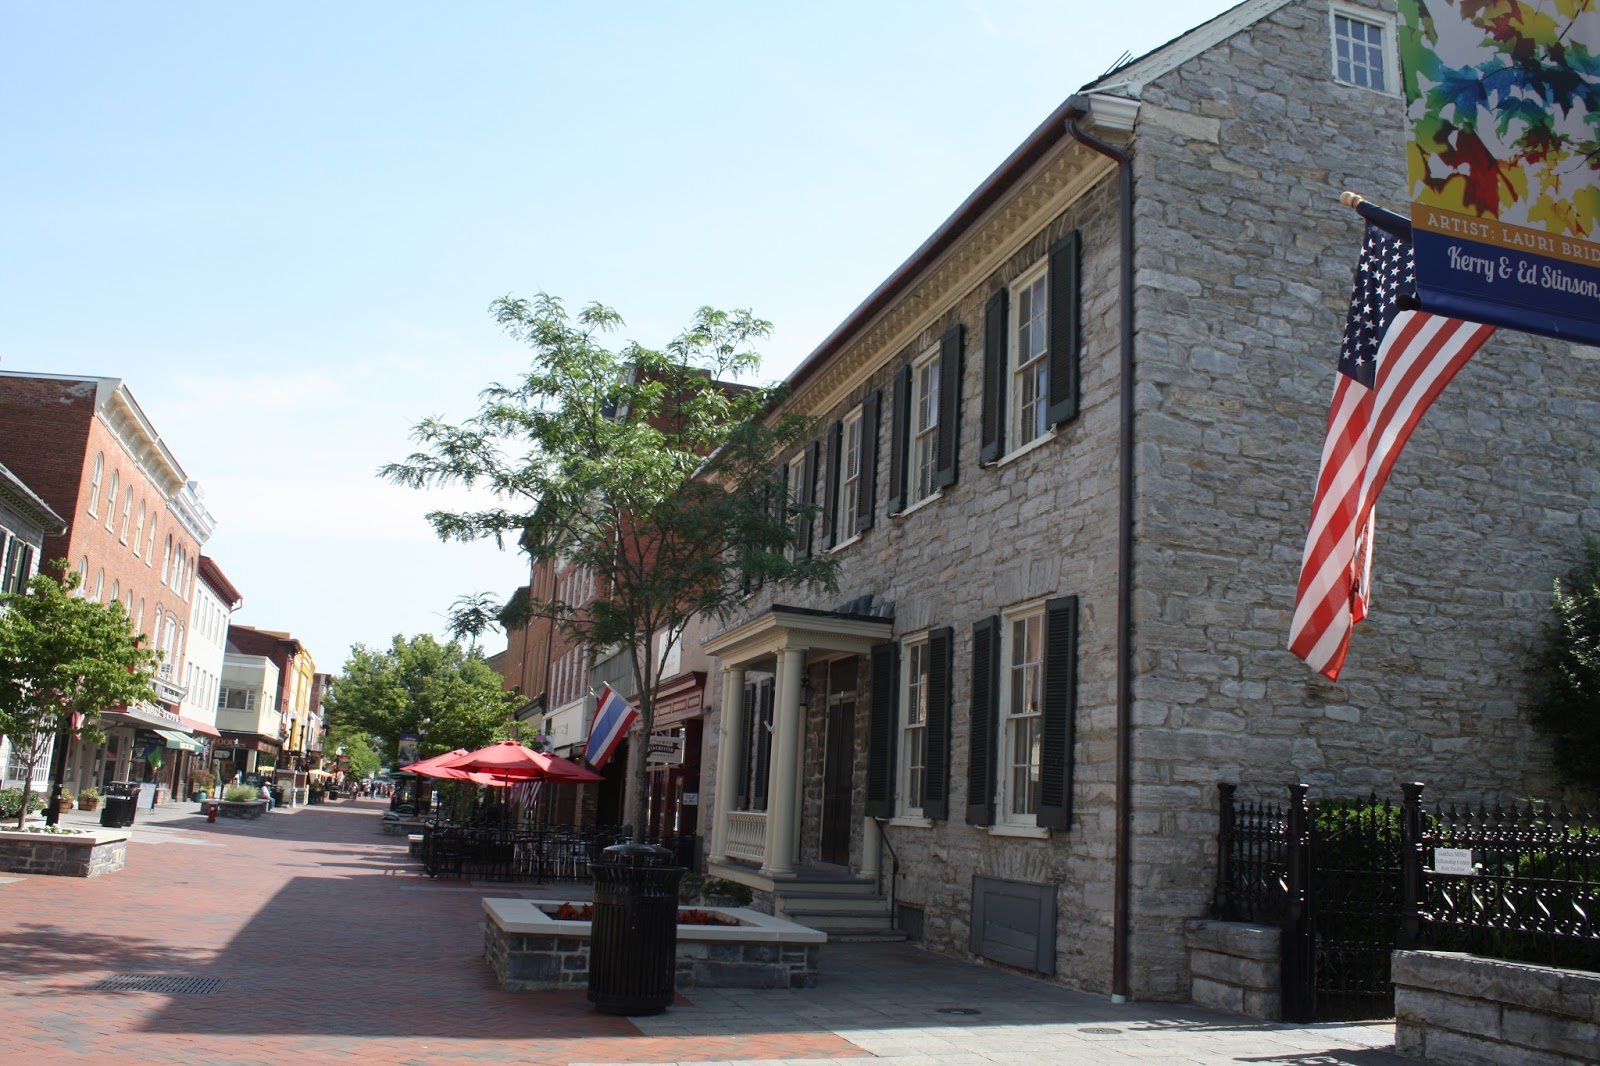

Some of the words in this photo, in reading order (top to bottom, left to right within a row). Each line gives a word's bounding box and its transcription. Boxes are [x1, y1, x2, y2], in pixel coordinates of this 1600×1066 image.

[1427, 213, 1495, 239] ARTIST:
[1502, 229, 1554, 252] LAURI
[1447, 246, 1494, 283] Kerry
[1498, 257, 1513, 279] &
[1517, 261, 1537, 285] Ed
